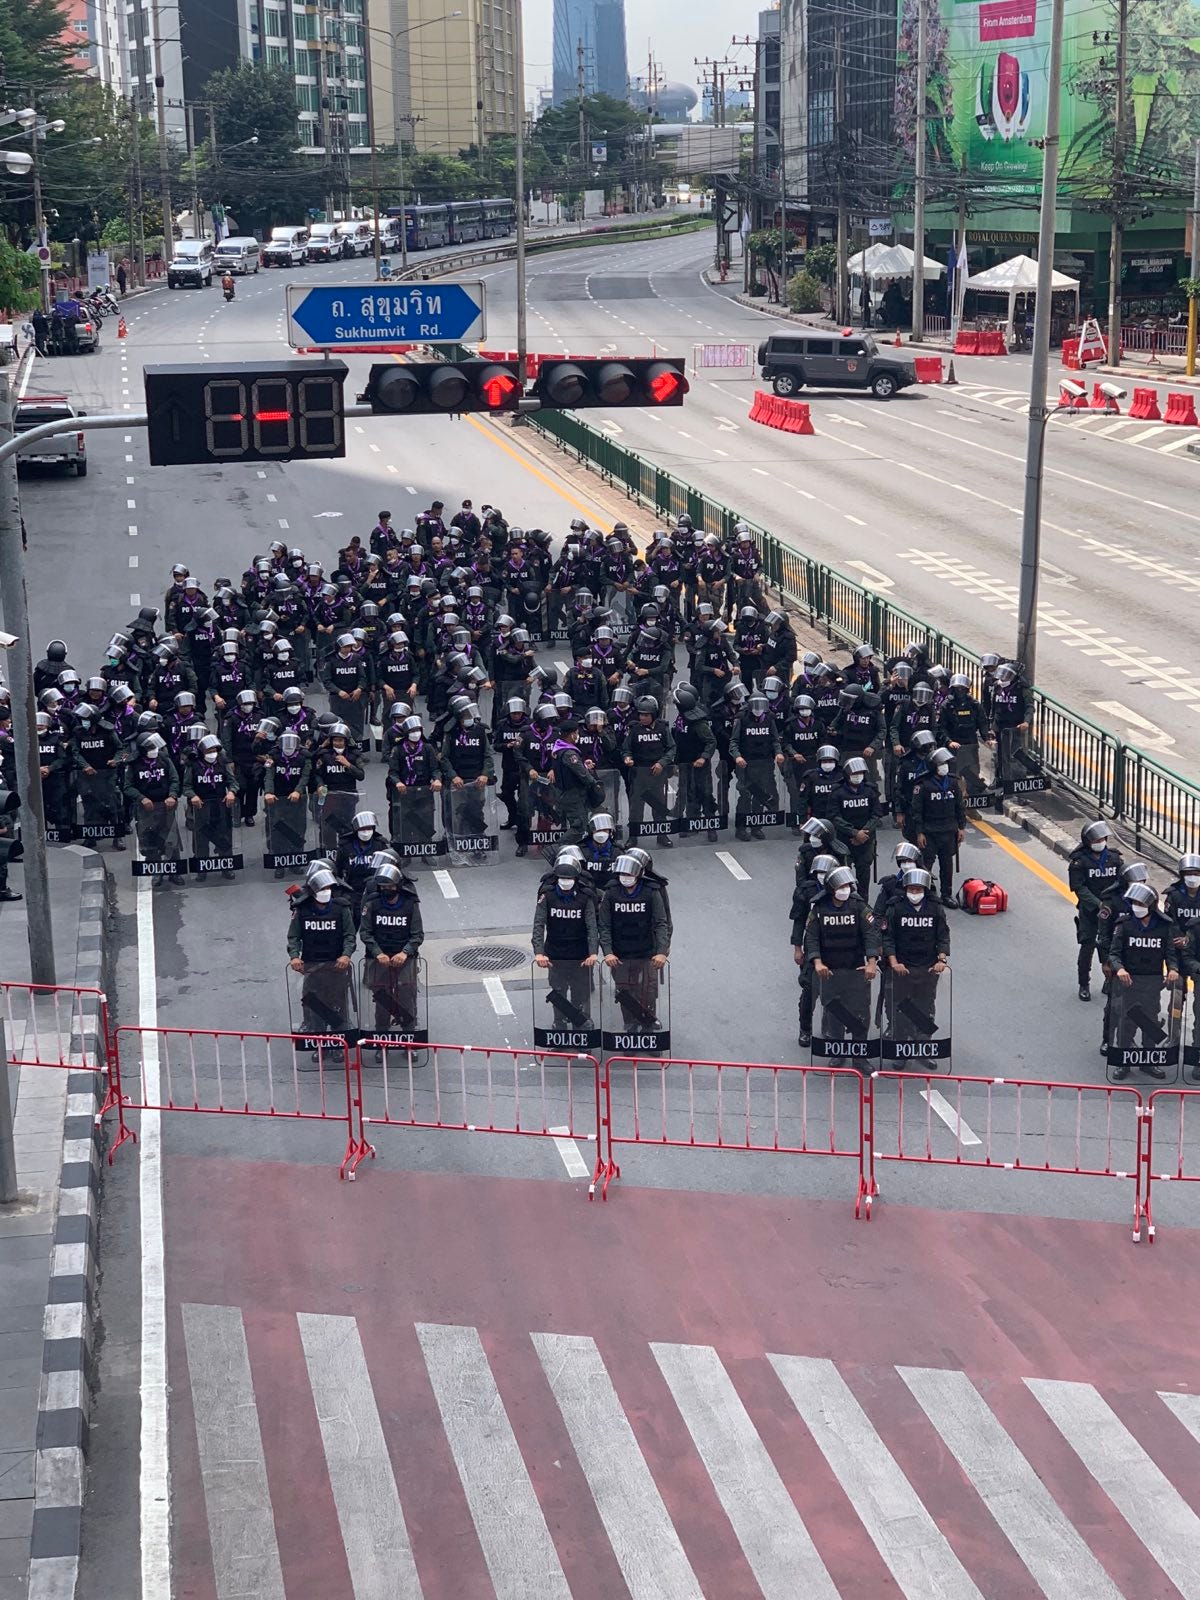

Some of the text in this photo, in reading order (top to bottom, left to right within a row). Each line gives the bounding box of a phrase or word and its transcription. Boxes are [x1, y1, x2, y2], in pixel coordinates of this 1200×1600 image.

[983, 14, 1033, 27] From Amsterdam
[968, 231, 1036, 243] ROYAL QUEEN SEEDS
[332, 289, 441, 323] ถ. สุขุมวิท
[335, 324, 443, 339] Sukhumvit Rd.
[550, 631, 569, 639] POLIC
[388, 664, 409, 672] POLICE
[503, 732, 521, 740] POLIC
[746, 727, 769, 735] POLICE
[39, 745, 55, 753] LICE
[81, 740, 104, 749] POLICE
[276, 766, 300, 775] POICE
[327, 765, 346, 773] POLIC
[197, 775, 223, 784] POLCE
[1014, 779, 1044, 792] POLICE
[843, 798, 868, 808] POLICE
[689, 818, 720, 830] POLICE
[746, 814, 776, 825] POLICE
[82, 826, 115, 837] POLICE
[640, 823, 671, 834] POLICE
[404, 844, 437, 855] POLICE
[456, 839, 490, 850] POLICE
[199, 858, 234, 871] POLICE
[274, 854, 308, 866] POLICE
[349, 855, 372, 865] POLIC
[142, 862, 177, 874] POLICE
[550, 907, 582, 919] POLICE
[615, 902, 646, 913] POLICE
[305, 920, 336, 930] POLICE
[376, 915, 407, 926] POLICE
[823, 915, 855, 926] POLICE
[901, 917, 933, 927] POLICE
[1129, 937, 1162, 948] POLICE
[304, 1033, 345, 1048] POLICE
[546, 1032, 588, 1046] POLICE
[615, 1035, 657, 1049] POLICE
[825, 1042, 867, 1055] POLICE
[895, 1043, 939, 1057] POLICE
[1123, 1051, 1167, 1064] POLICE
